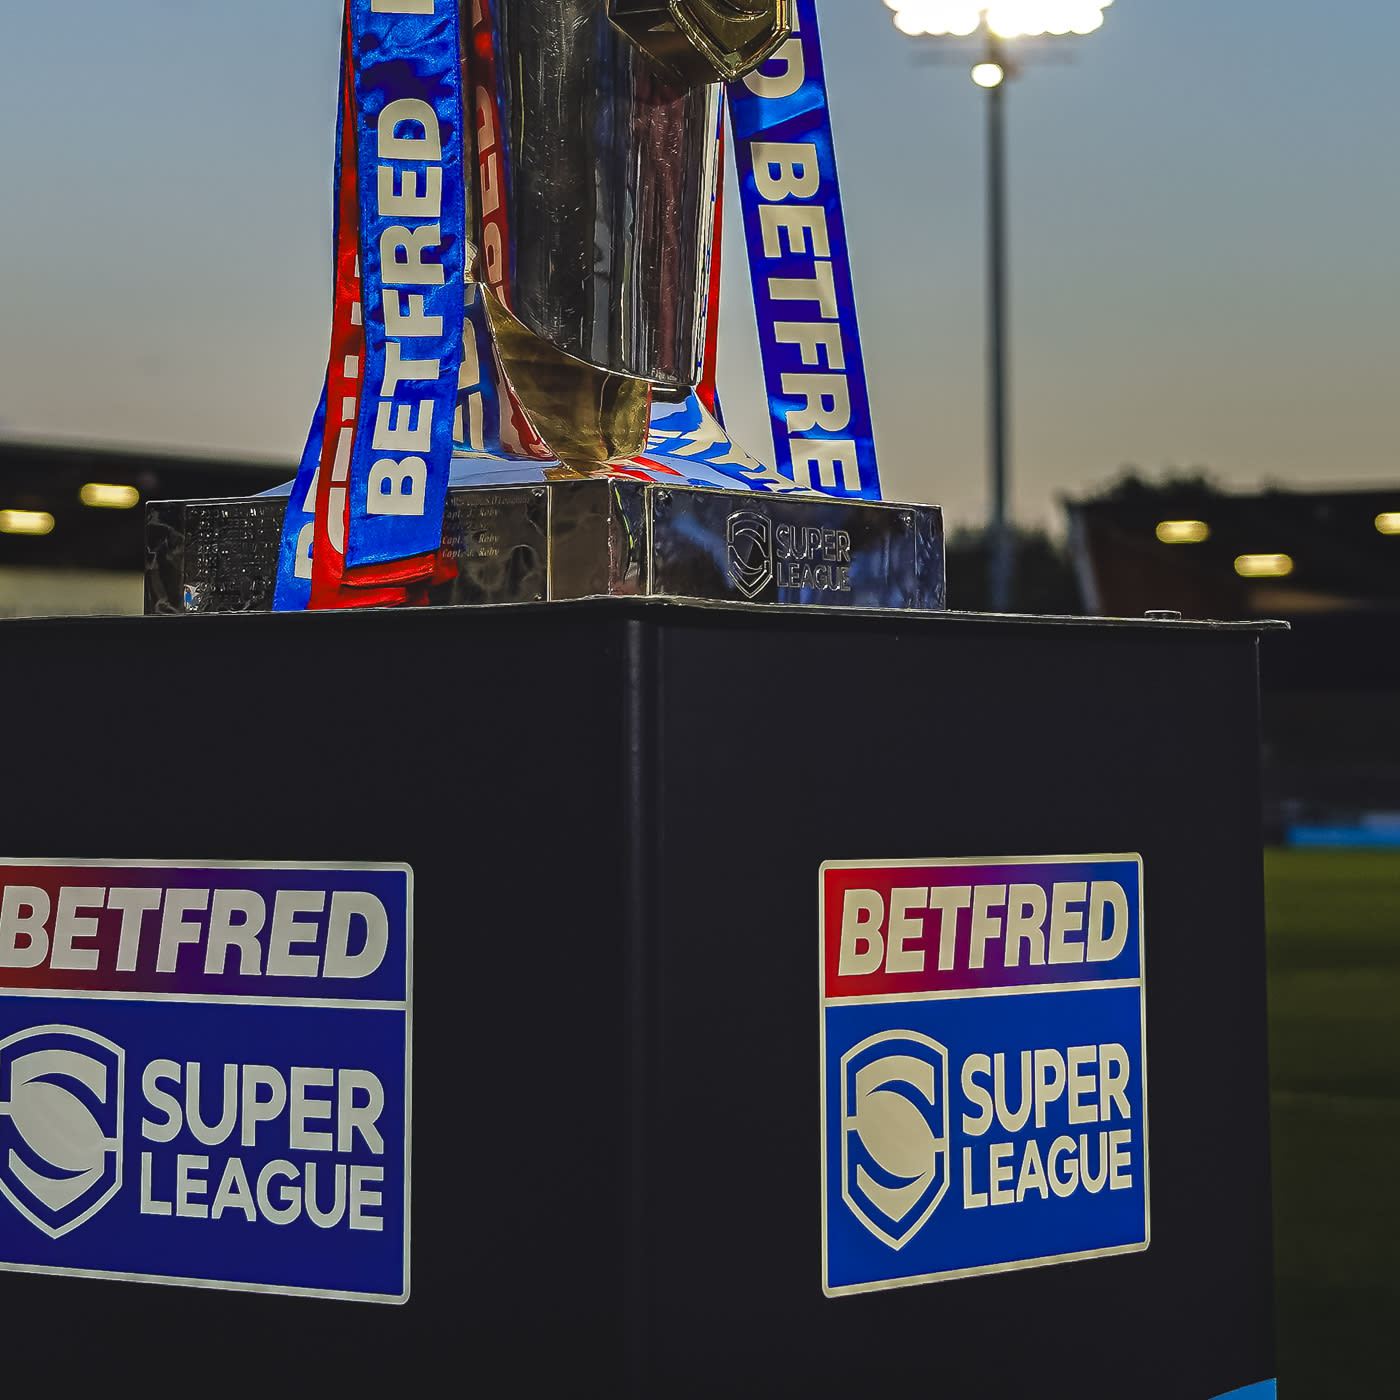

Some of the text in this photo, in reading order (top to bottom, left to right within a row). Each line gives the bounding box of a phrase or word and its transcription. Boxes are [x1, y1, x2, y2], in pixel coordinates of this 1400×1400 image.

[366, 98, 445, 516] BETFRED
[750, 141, 861, 493] BETFRE
[776, 523, 851, 562] SUPER
[776, 562, 851, 592] LEAGUE
[837, 880, 1129, 977] BETFRED
[141, 1058, 385, 1154] SUPER
[960, 1043, 1131, 1137] SUPER
[140, 1151, 384, 1231] LEAGUE
[962, 1128, 1133, 1210] LEAGUE
